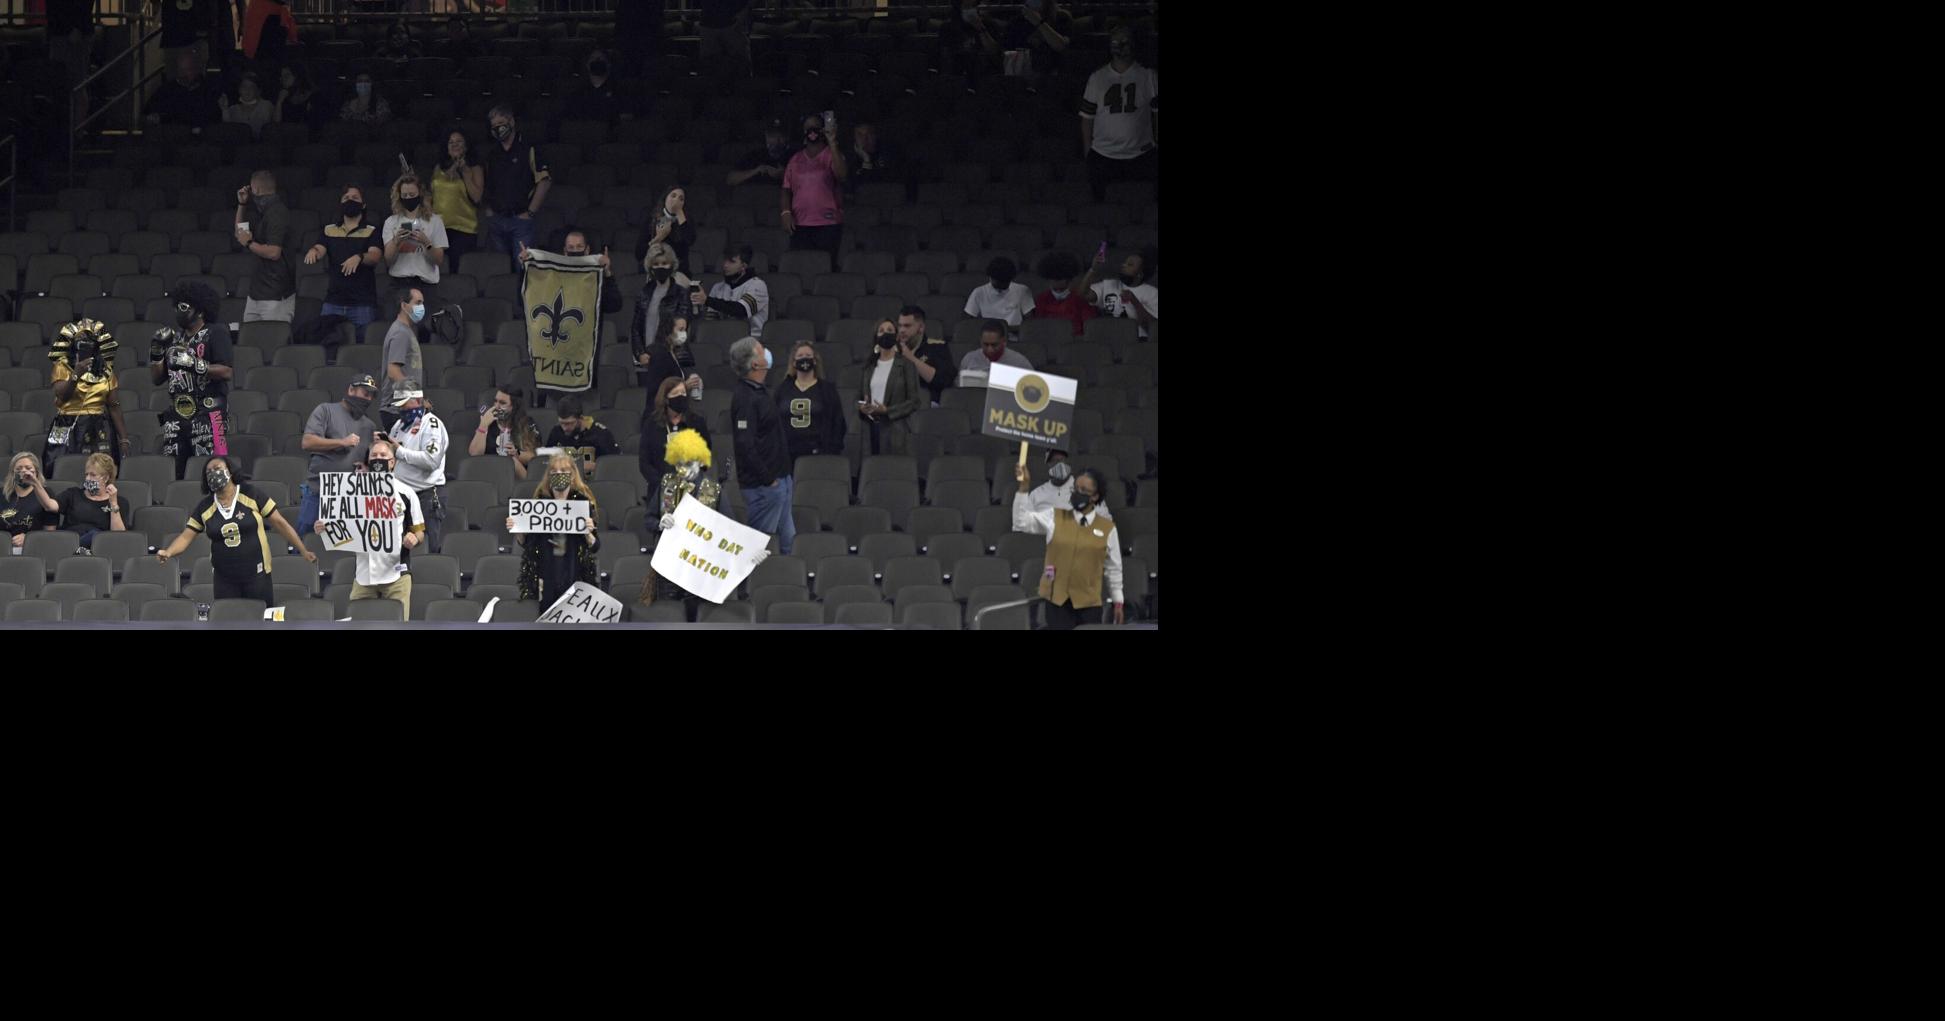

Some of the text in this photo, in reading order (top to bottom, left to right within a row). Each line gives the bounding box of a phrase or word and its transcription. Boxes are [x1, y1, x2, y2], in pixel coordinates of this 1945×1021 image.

[1104, 83, 1137, 114] 41
[790, 398, 811, 428] 9
[989, 408, 1067, 437] MASK UP
[322, 473, 343, 496] HEY
[320, 496, 397, 519] WE ALL MASK
[221, 522, 241, 548] 9
[324, 519, 393, 553] FOR YOU
[529, 515, 587, 532] PROUD
[685, 518, 744, 556] WHO DAT
[678, 548, 729, 580] NATION
